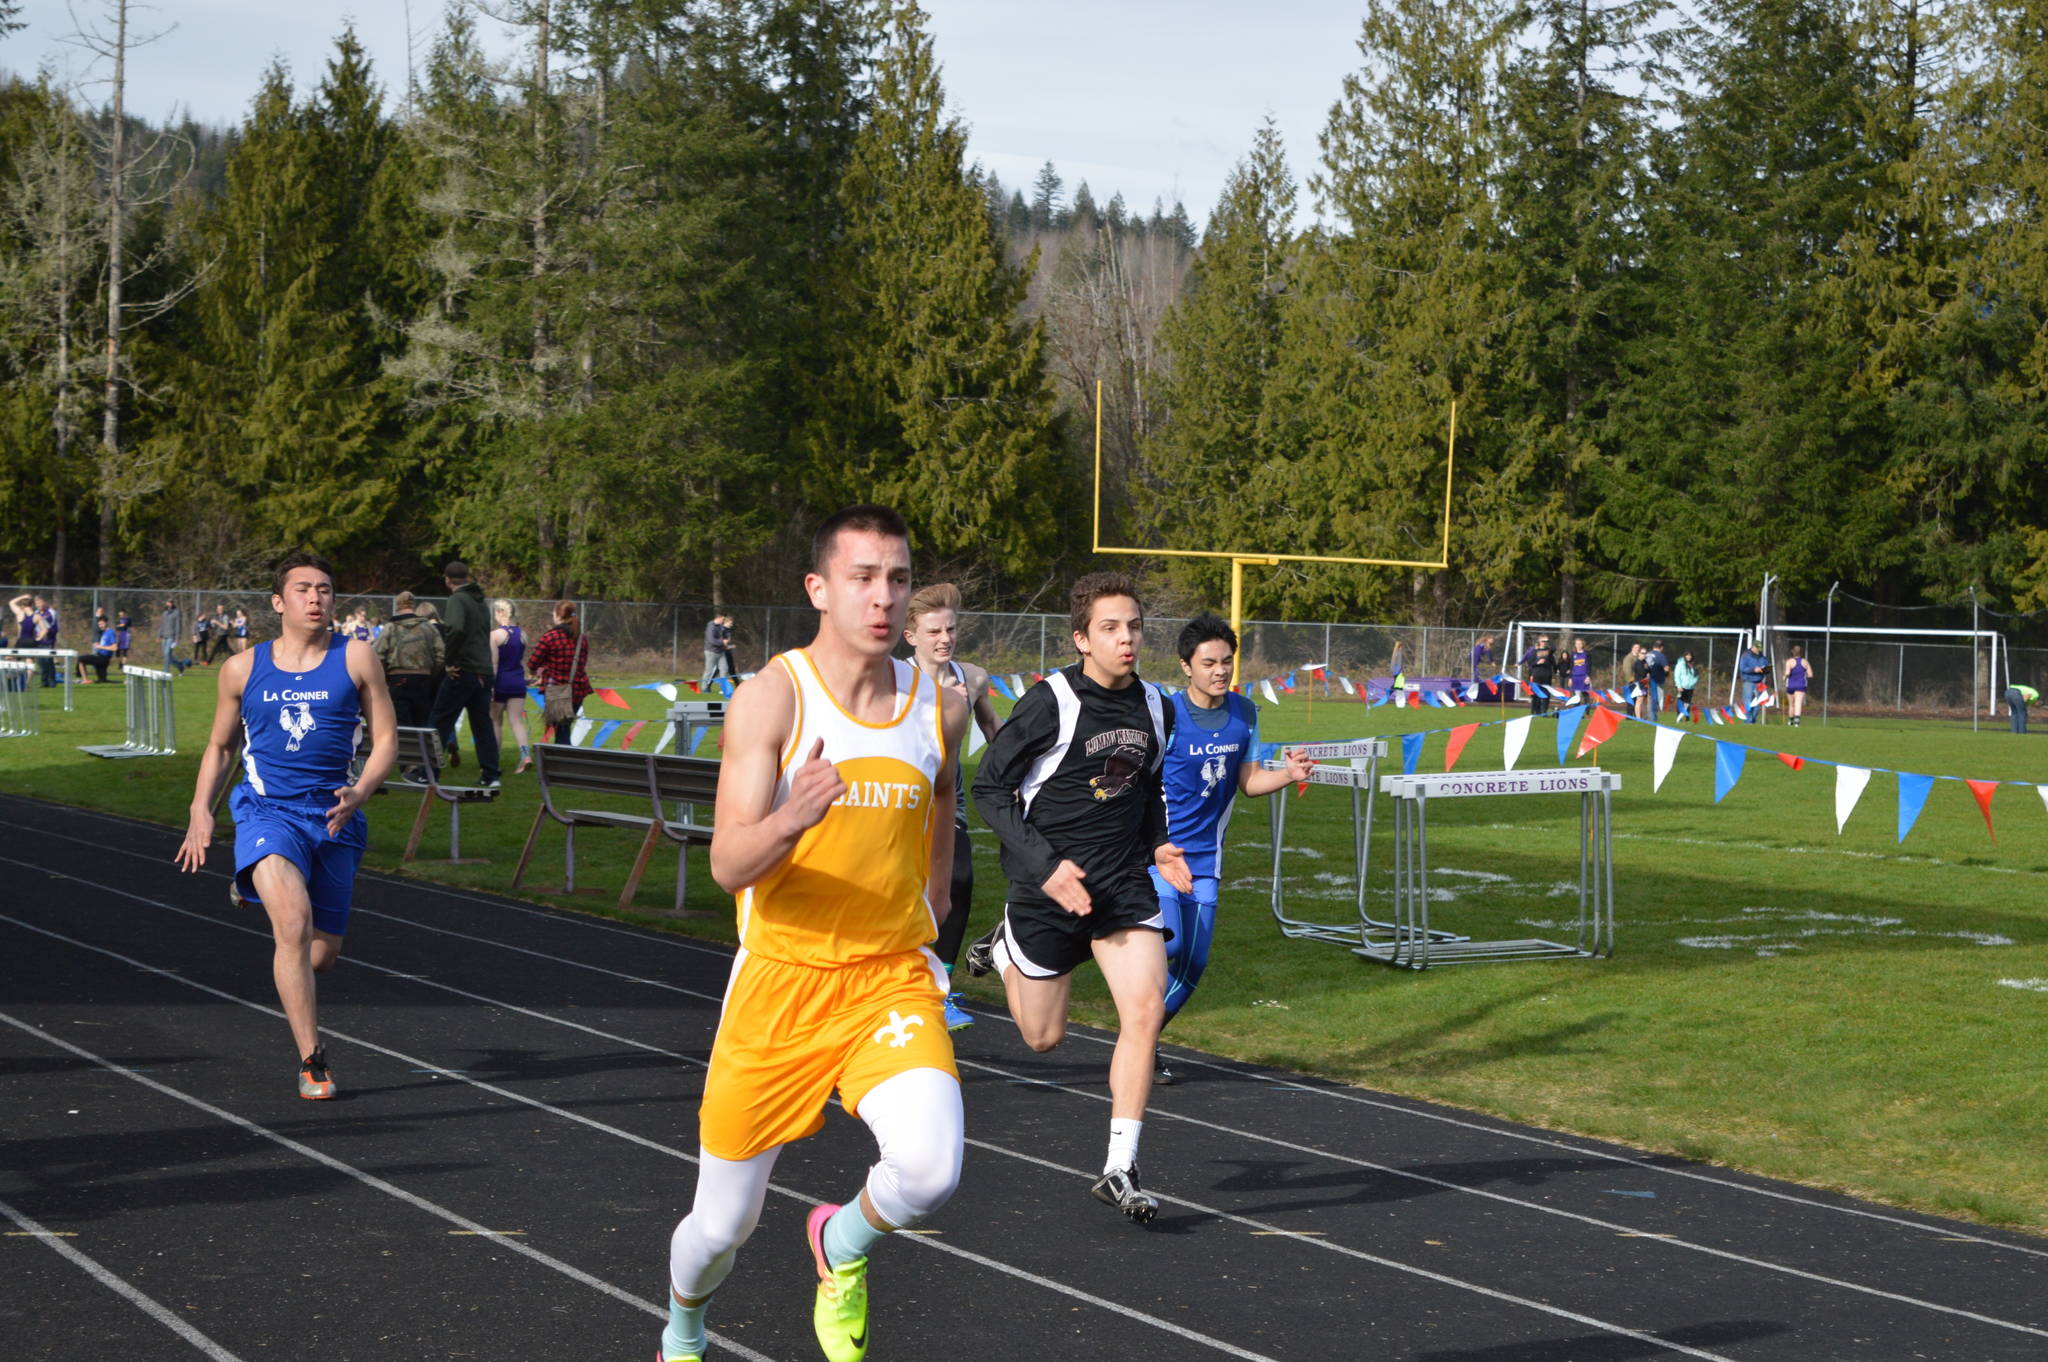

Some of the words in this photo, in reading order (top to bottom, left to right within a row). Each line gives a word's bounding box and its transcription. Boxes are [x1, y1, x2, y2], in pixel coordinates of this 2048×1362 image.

[1085, 730, 1116, 757] LUMMI
[1115, 728, 1149, 748] NATION
[1304, 746, 1339, 758] NCRETE
[1343, 744, 1368, 756] LIONS
[1325, 772, 1349, 785] LIONS
[1440, 780, 1529, 795] CONCRETE
[1540, 777, 1588, 791] LIONS
